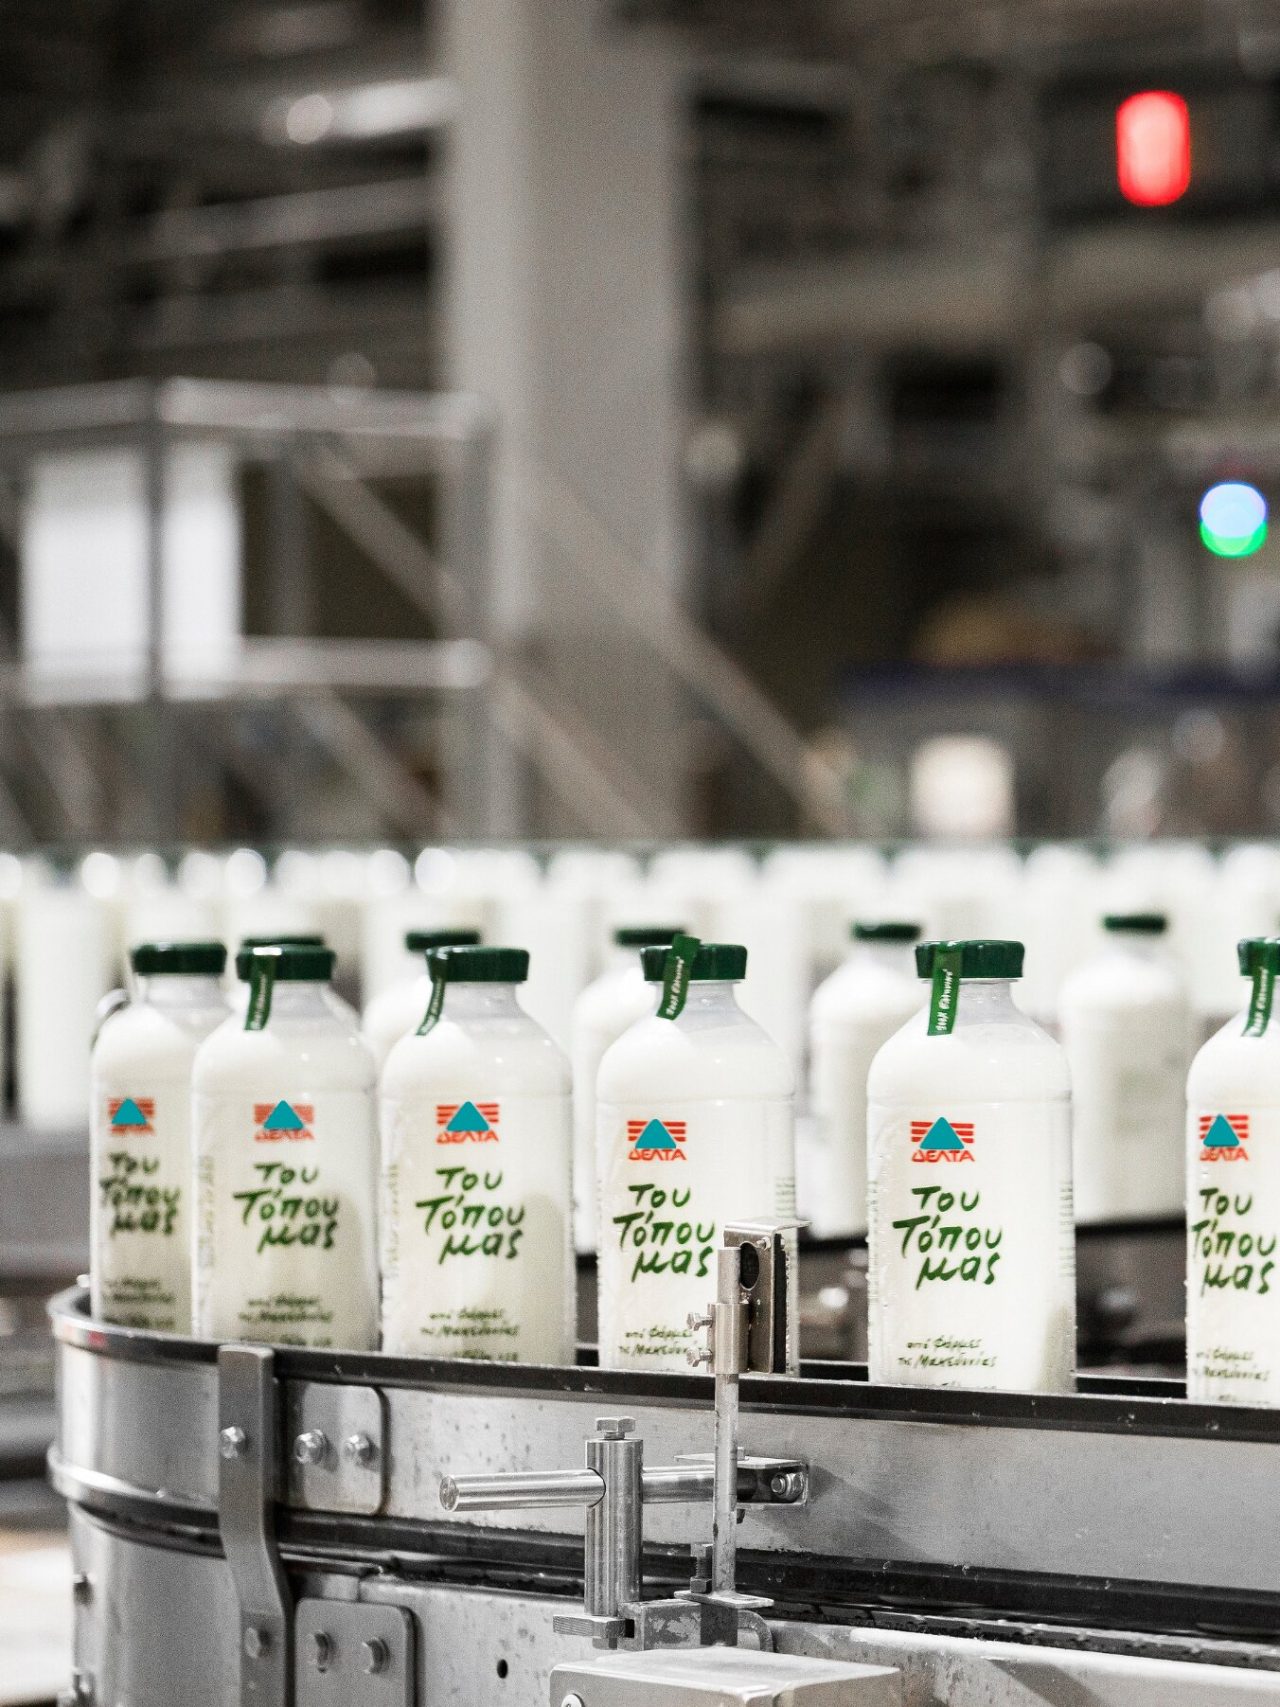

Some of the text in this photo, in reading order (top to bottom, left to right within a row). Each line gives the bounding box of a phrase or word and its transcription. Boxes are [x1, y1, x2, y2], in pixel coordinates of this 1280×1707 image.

[628, 1148, 688, 1161] ΔΕΛΤΑ
[911, 1149, 976, 1163] ΔΕΛΤΑ
[254, 1161, 318, 1184] Του
[436, 1166, 503, 1191] Του
[628, 1183, 691, 1208] Του
[911, 1185, 980, 1212] Του
[1199, 1187, 1253, 1216] Του
[415, 1194, 526, 1235] Τόπου
[613, 1210, 715, 1250] Τόπου
[438, 1228, 524, 1265] μας
[892, 1215, 1003, 1258] Τόπου
[631, 1246, 714, 1283] μας
[915, 1252, 1001, 1290] μας
[1200, 1260, 1275, 1297] μας
